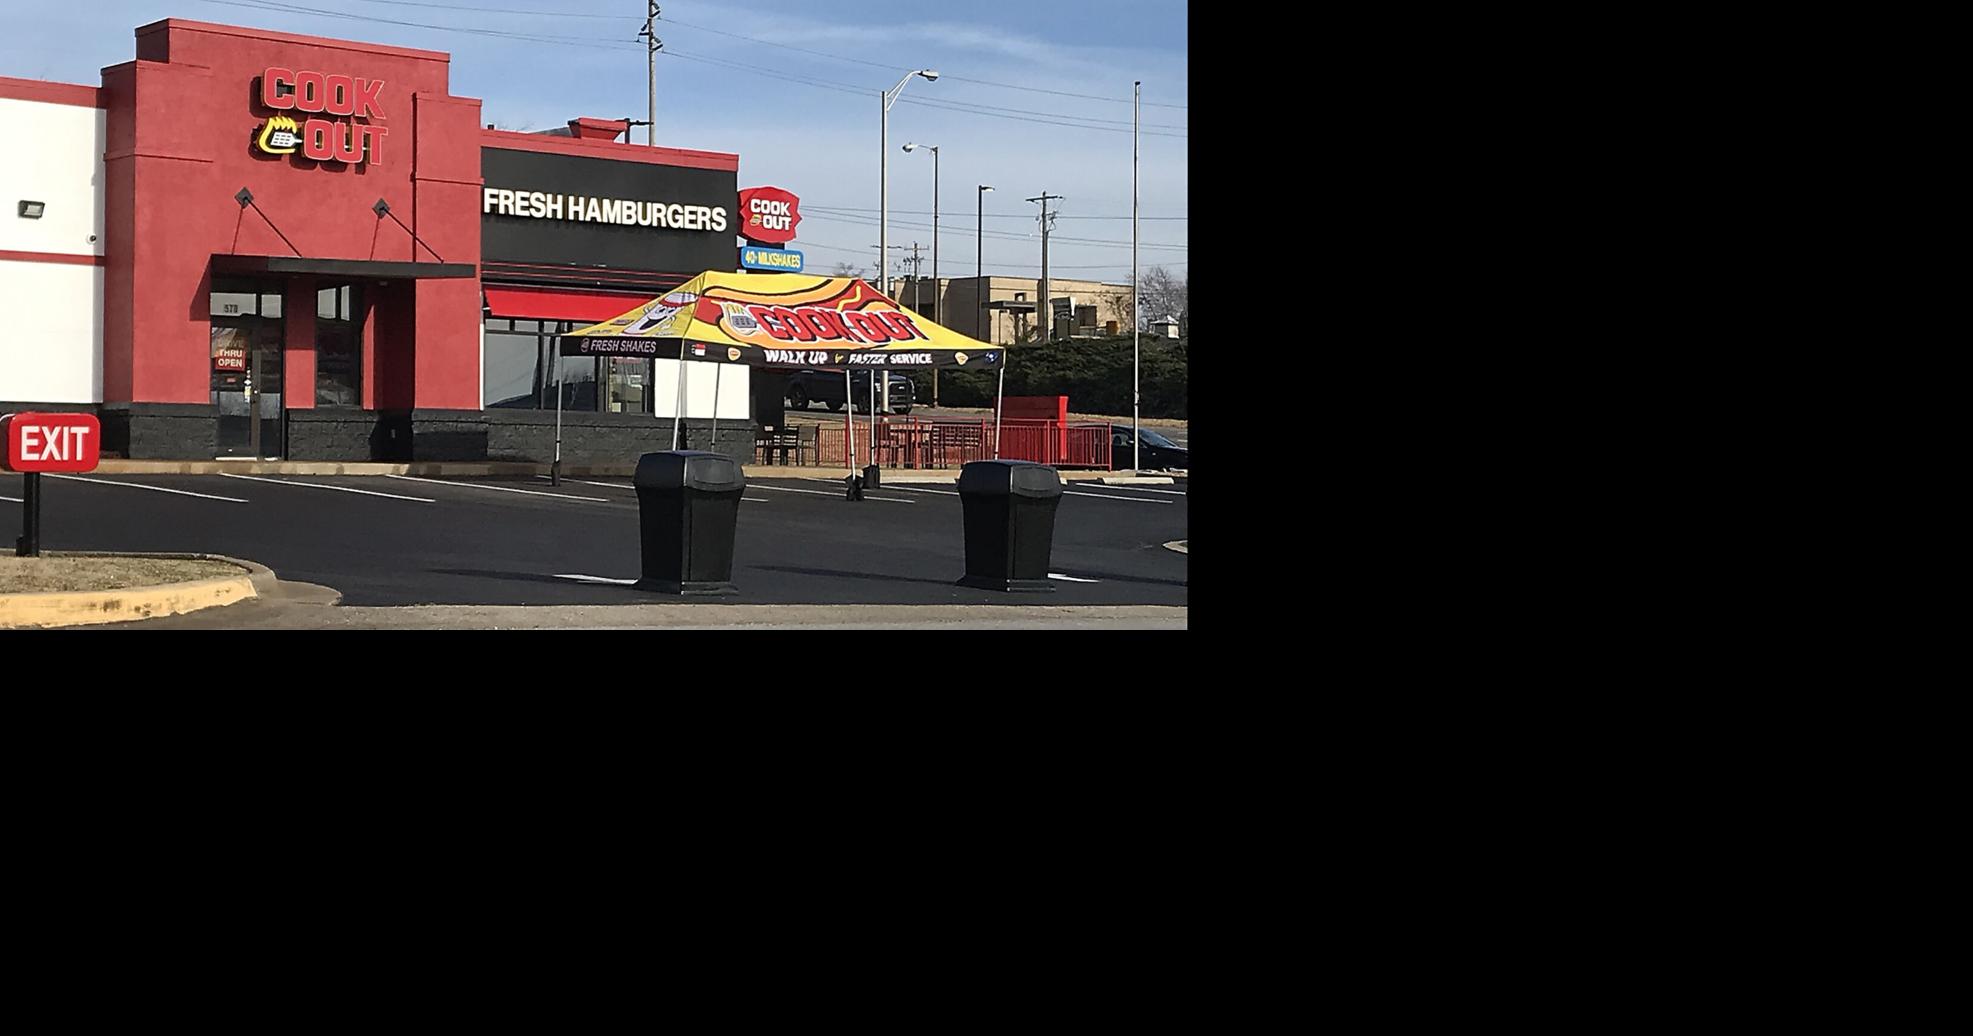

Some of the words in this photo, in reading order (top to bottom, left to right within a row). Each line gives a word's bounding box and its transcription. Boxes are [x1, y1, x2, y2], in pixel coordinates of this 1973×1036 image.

[264, 67, 386, 119] COOK
[304, 119, 389, 165] OUT
[484, 187, 563, 218] FRESH
[568, 197, 727, 232] HAMBURGERS
[751, 199, 791, 216] COOK
[763, 215, 791, 231] OUT
[758, 252, 800, 268] MILKSHAKES
[748, 306, 864, 343] COOK
[845, 311, 929, 342] OUT
[219, 349, 243, 357] THRU
[591, 340, 619, 351] FRESH
[620, 341, 656, 353] SHAKES
[218, 358, 242, 367] OPEN
[764, 350, 806, 363] WALK
[808, 351, 828, 364] UP
[849, 353, 888, 364] FASTER
[890, 353, 932, 364] SERVICE
[21, 426, 90, 461] EXIT
